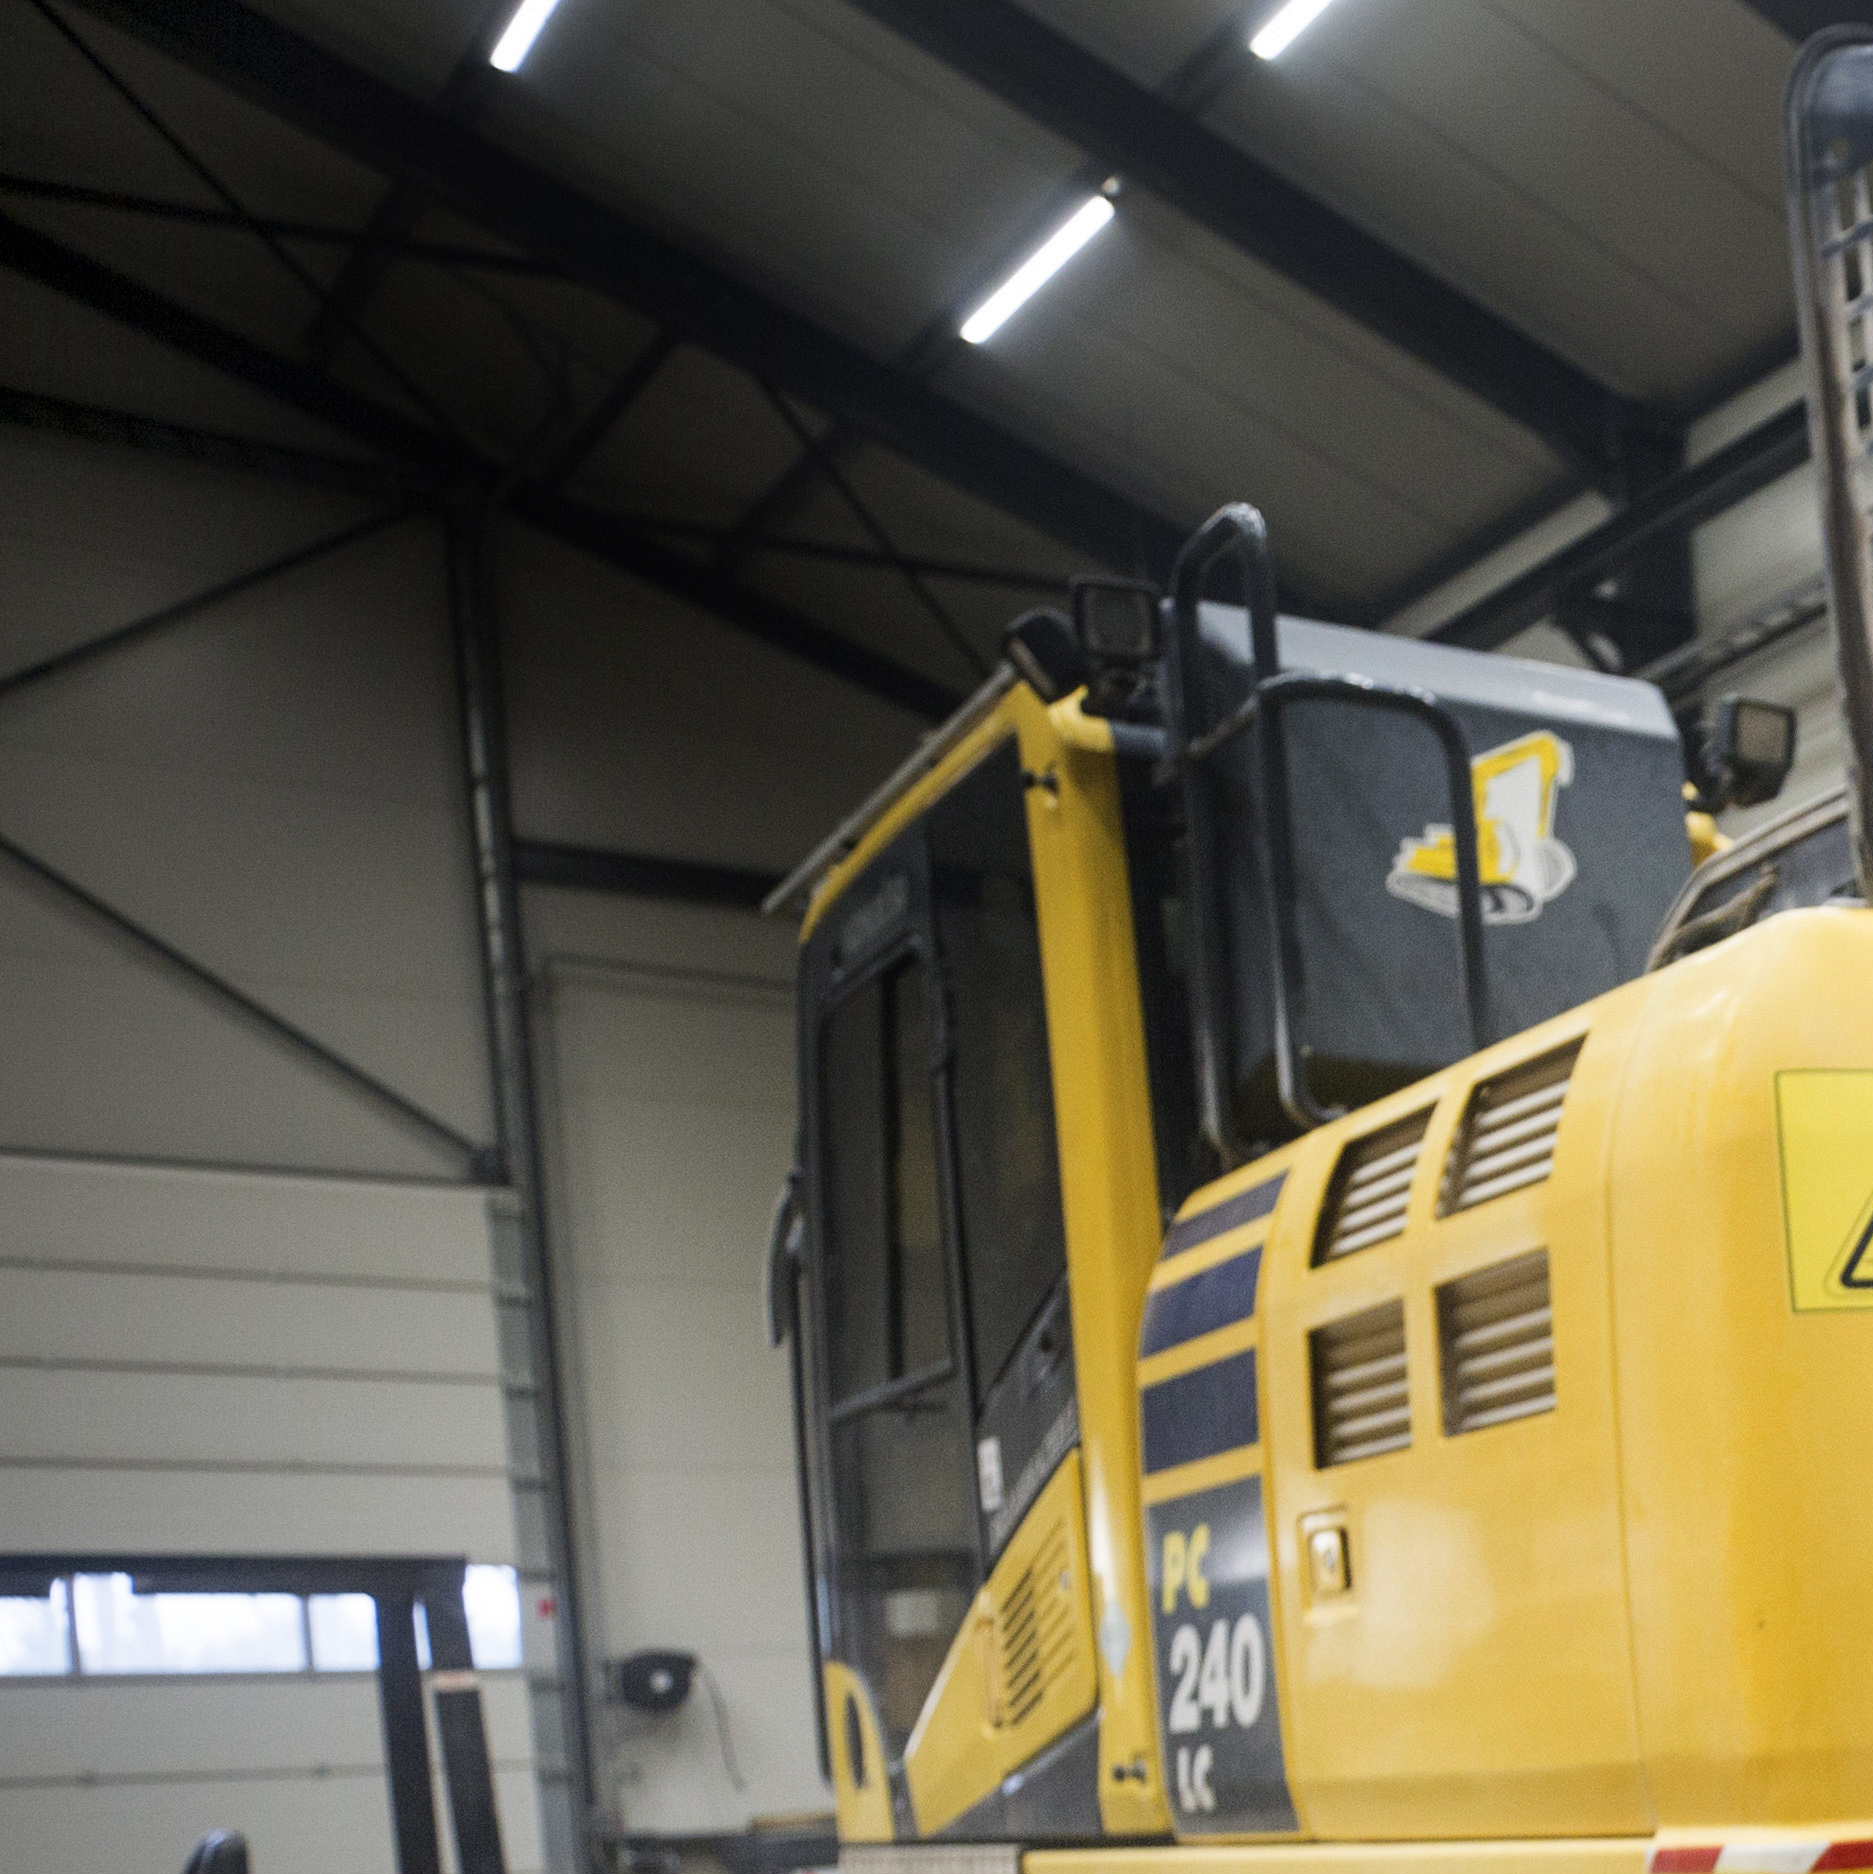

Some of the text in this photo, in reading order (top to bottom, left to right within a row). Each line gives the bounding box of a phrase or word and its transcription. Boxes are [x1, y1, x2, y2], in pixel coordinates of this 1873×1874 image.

[1161, 1523, 1211, 1615] PC
[1169, 1613, 1266, 1734] 240
[1176, 1744, 1215, 1813] LC
